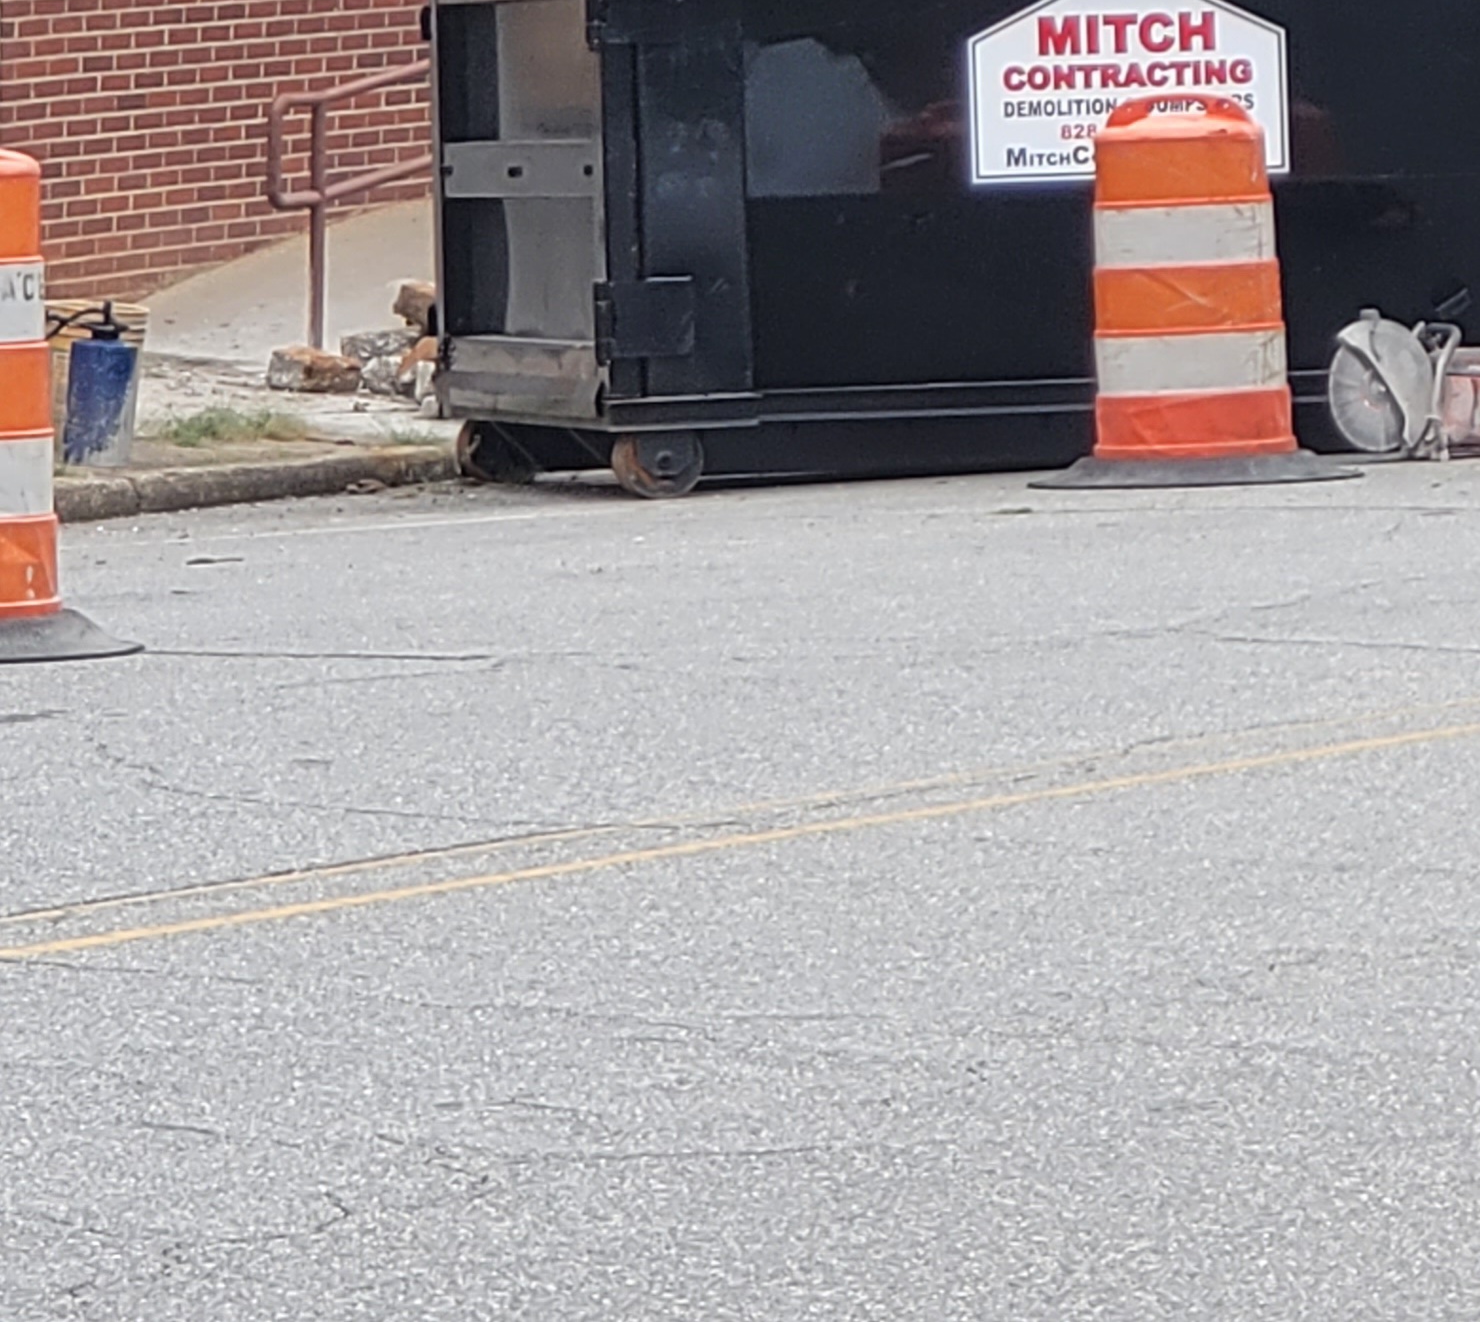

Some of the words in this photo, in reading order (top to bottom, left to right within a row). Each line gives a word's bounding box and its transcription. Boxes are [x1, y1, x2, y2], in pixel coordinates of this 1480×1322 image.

[1037, 11, 1216, 57] MITCH
[1003, 59, 1253, 92] CONTRACTING
[1003, 97, 1118, 119] DEMOLITION
